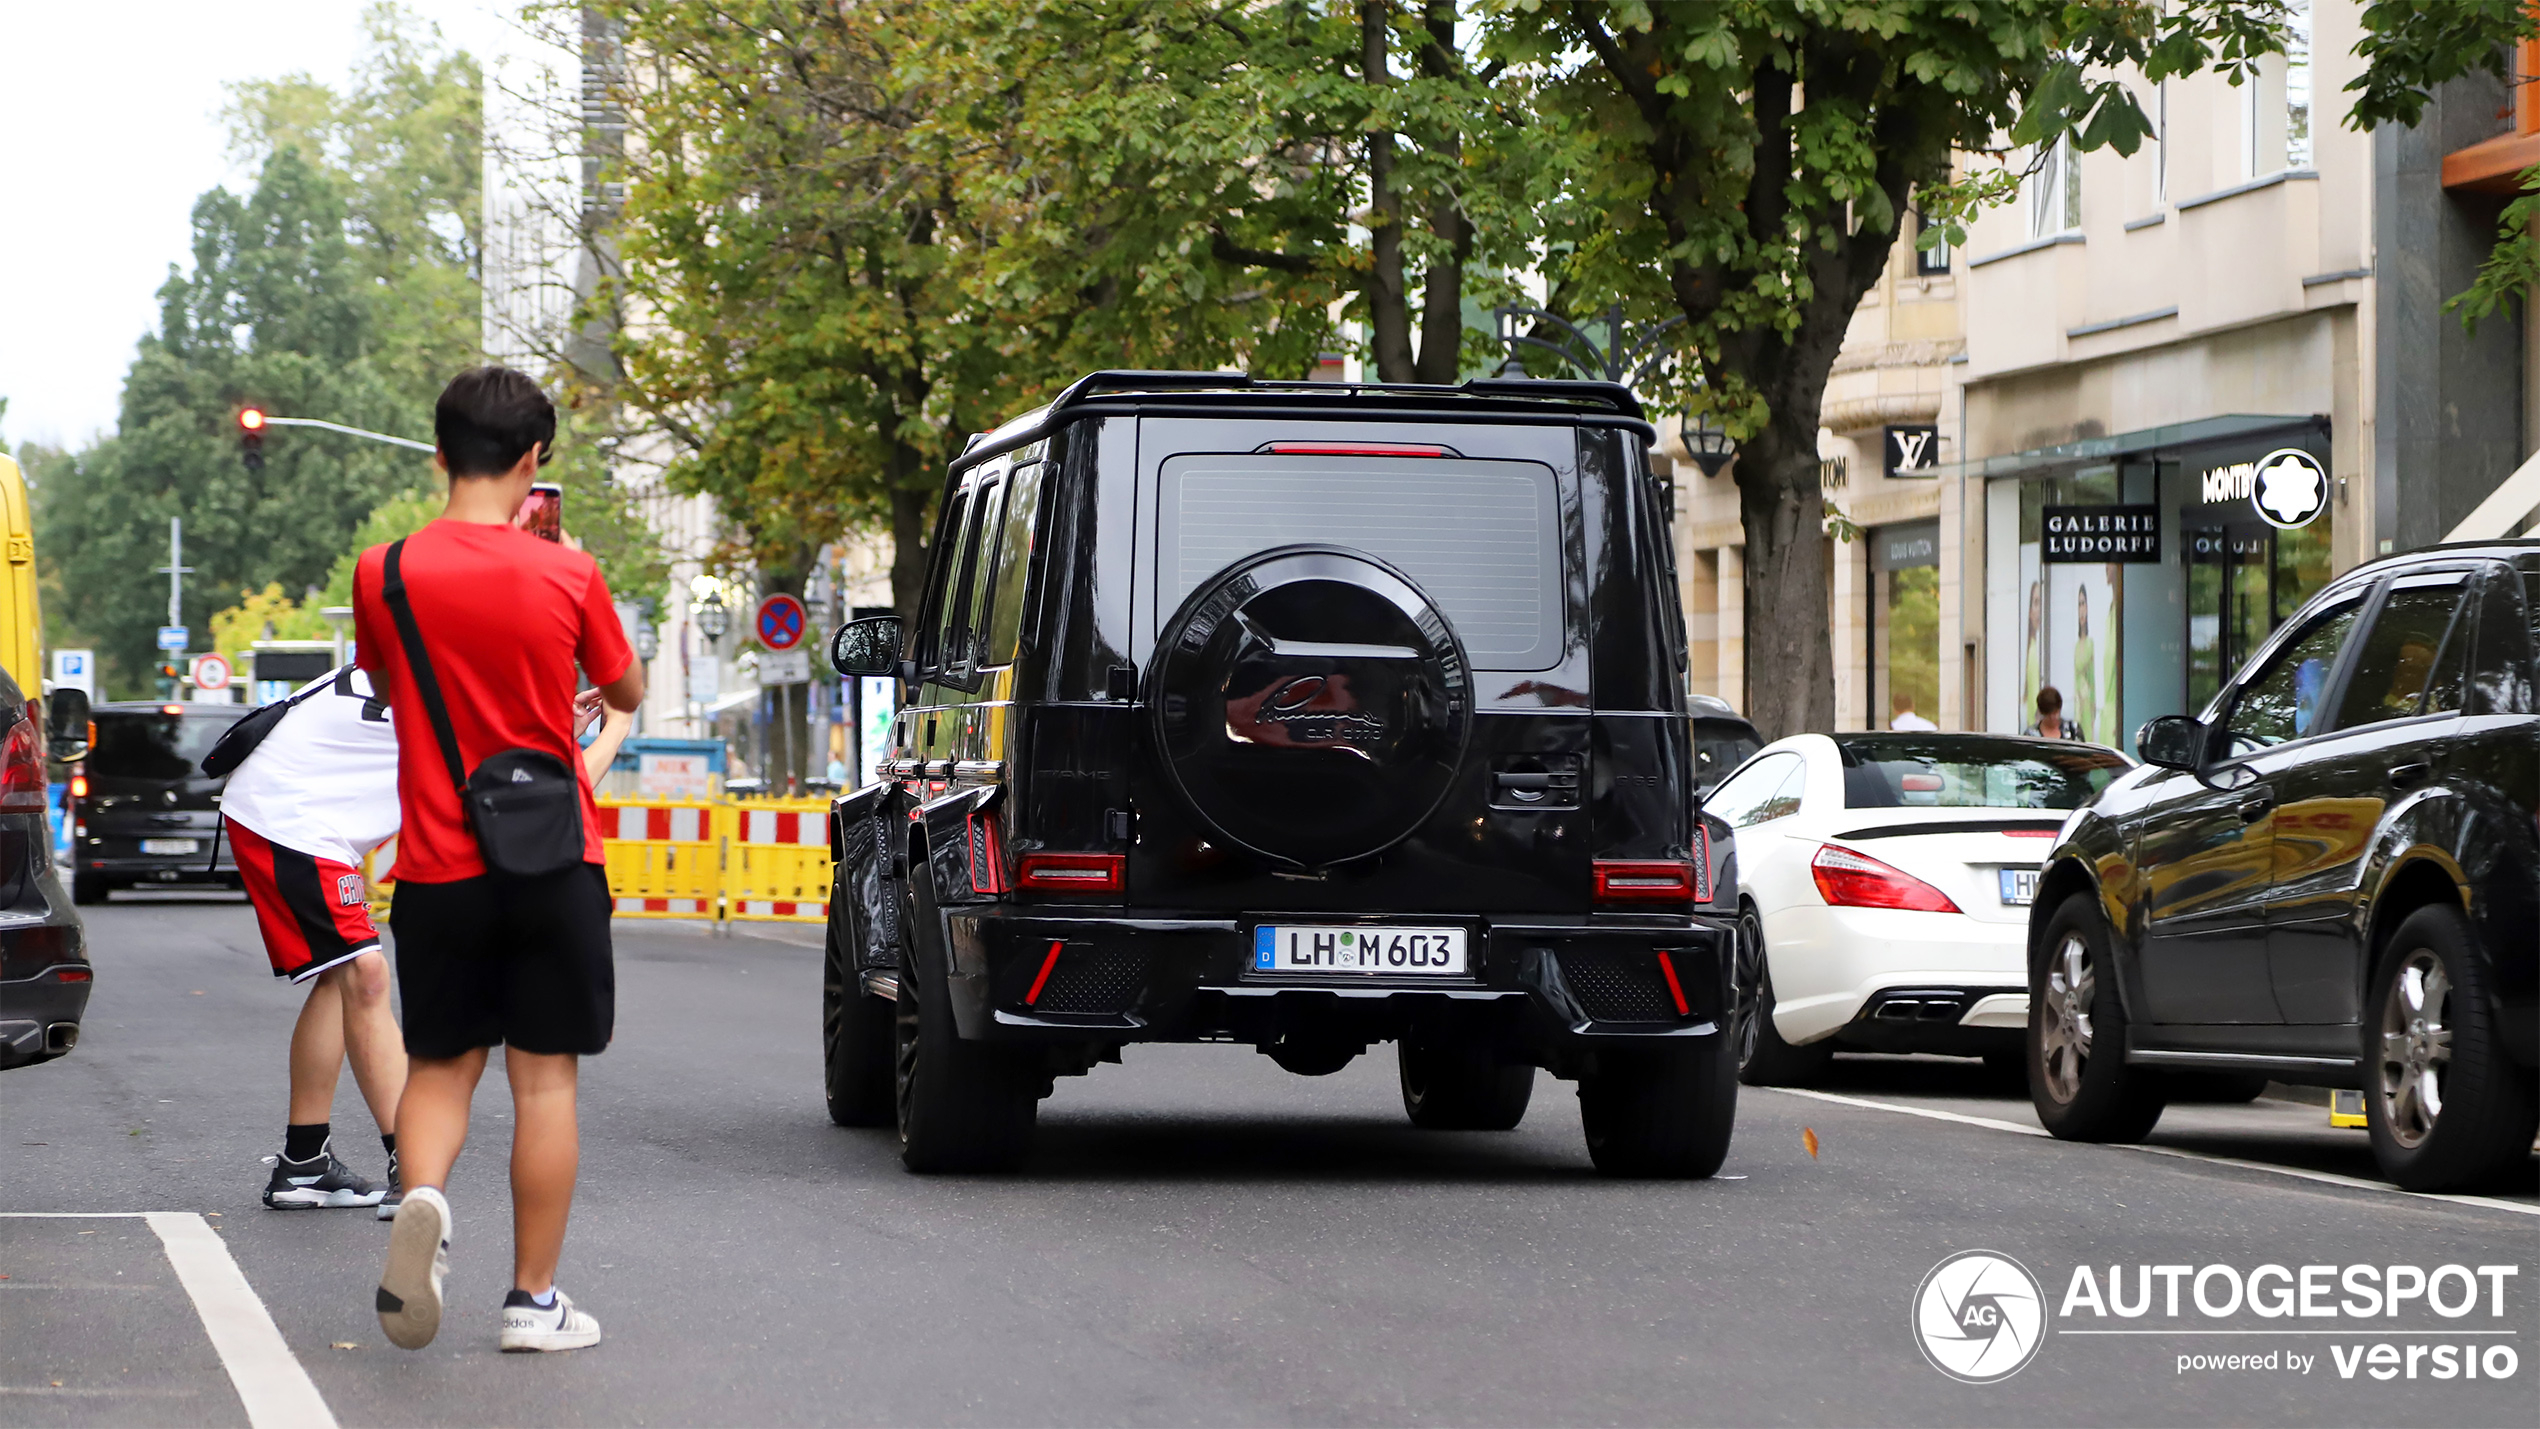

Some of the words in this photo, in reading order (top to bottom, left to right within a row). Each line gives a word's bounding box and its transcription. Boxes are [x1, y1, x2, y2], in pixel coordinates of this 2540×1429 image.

[2049, 515, 2155, 533] GALERIE
[2049, 536, 2155, 554] LUDORFF
[1262, 952, 1270, 962] D
[1291, 932, 1335, 966] LH
[1359, 934, 1380, 966] M
[1388, 935, 1450, 967] 603
